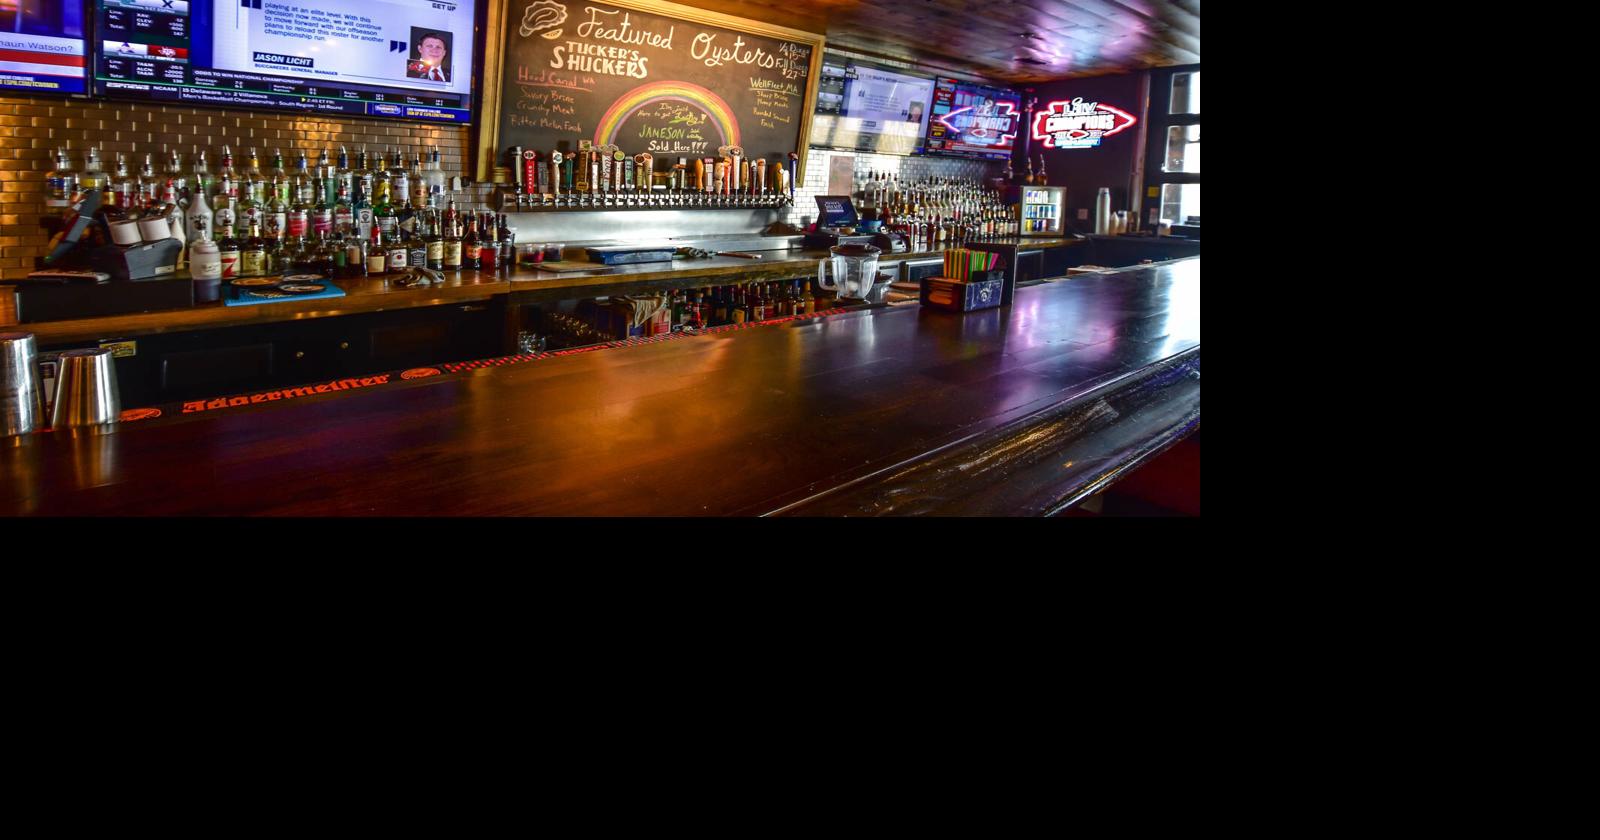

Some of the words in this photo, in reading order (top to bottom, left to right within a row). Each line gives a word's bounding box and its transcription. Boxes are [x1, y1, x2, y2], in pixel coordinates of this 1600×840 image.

[264, 2, 290, 11] playing
[310, 8, 325, 16] elite
[432, 2, 446, 10] GET
[264, 9, 294, 18] decision
[355, 21, 382, 30] continue
[264, 22, 284, 30] plans
[295, 25, 316, 34] reload
[317, 28, 329, 36] this
[331, 30, 349, 38] roster
[360, 34, 384, 43] another
[294, 18, 320, 27] forward
[321, 22, 334, 30] with
[347, 25, 378, 36] offseason
[264, 28, 313, 41] championship
[577, 6, 674, 50] Featured
[691, 32, 775, 68] Oysters
[28, 42, 73, 53] Watson?
[566, 41, 640, 62] TUCKER'S
[255, 53, 284, 63] JASON
[286, 56, 312, 66] LICHT
[550, 46, 649, 79] SHUCKERS
[254, 63, 290, 71] BUCCANEERS
[262, 76, 304, 84] CHAMPIONSHIP
[233, 97, 275, 105] Championship
[638, 124, 686, 140] JAMESON
[648, 140, 669, 151] Sold
